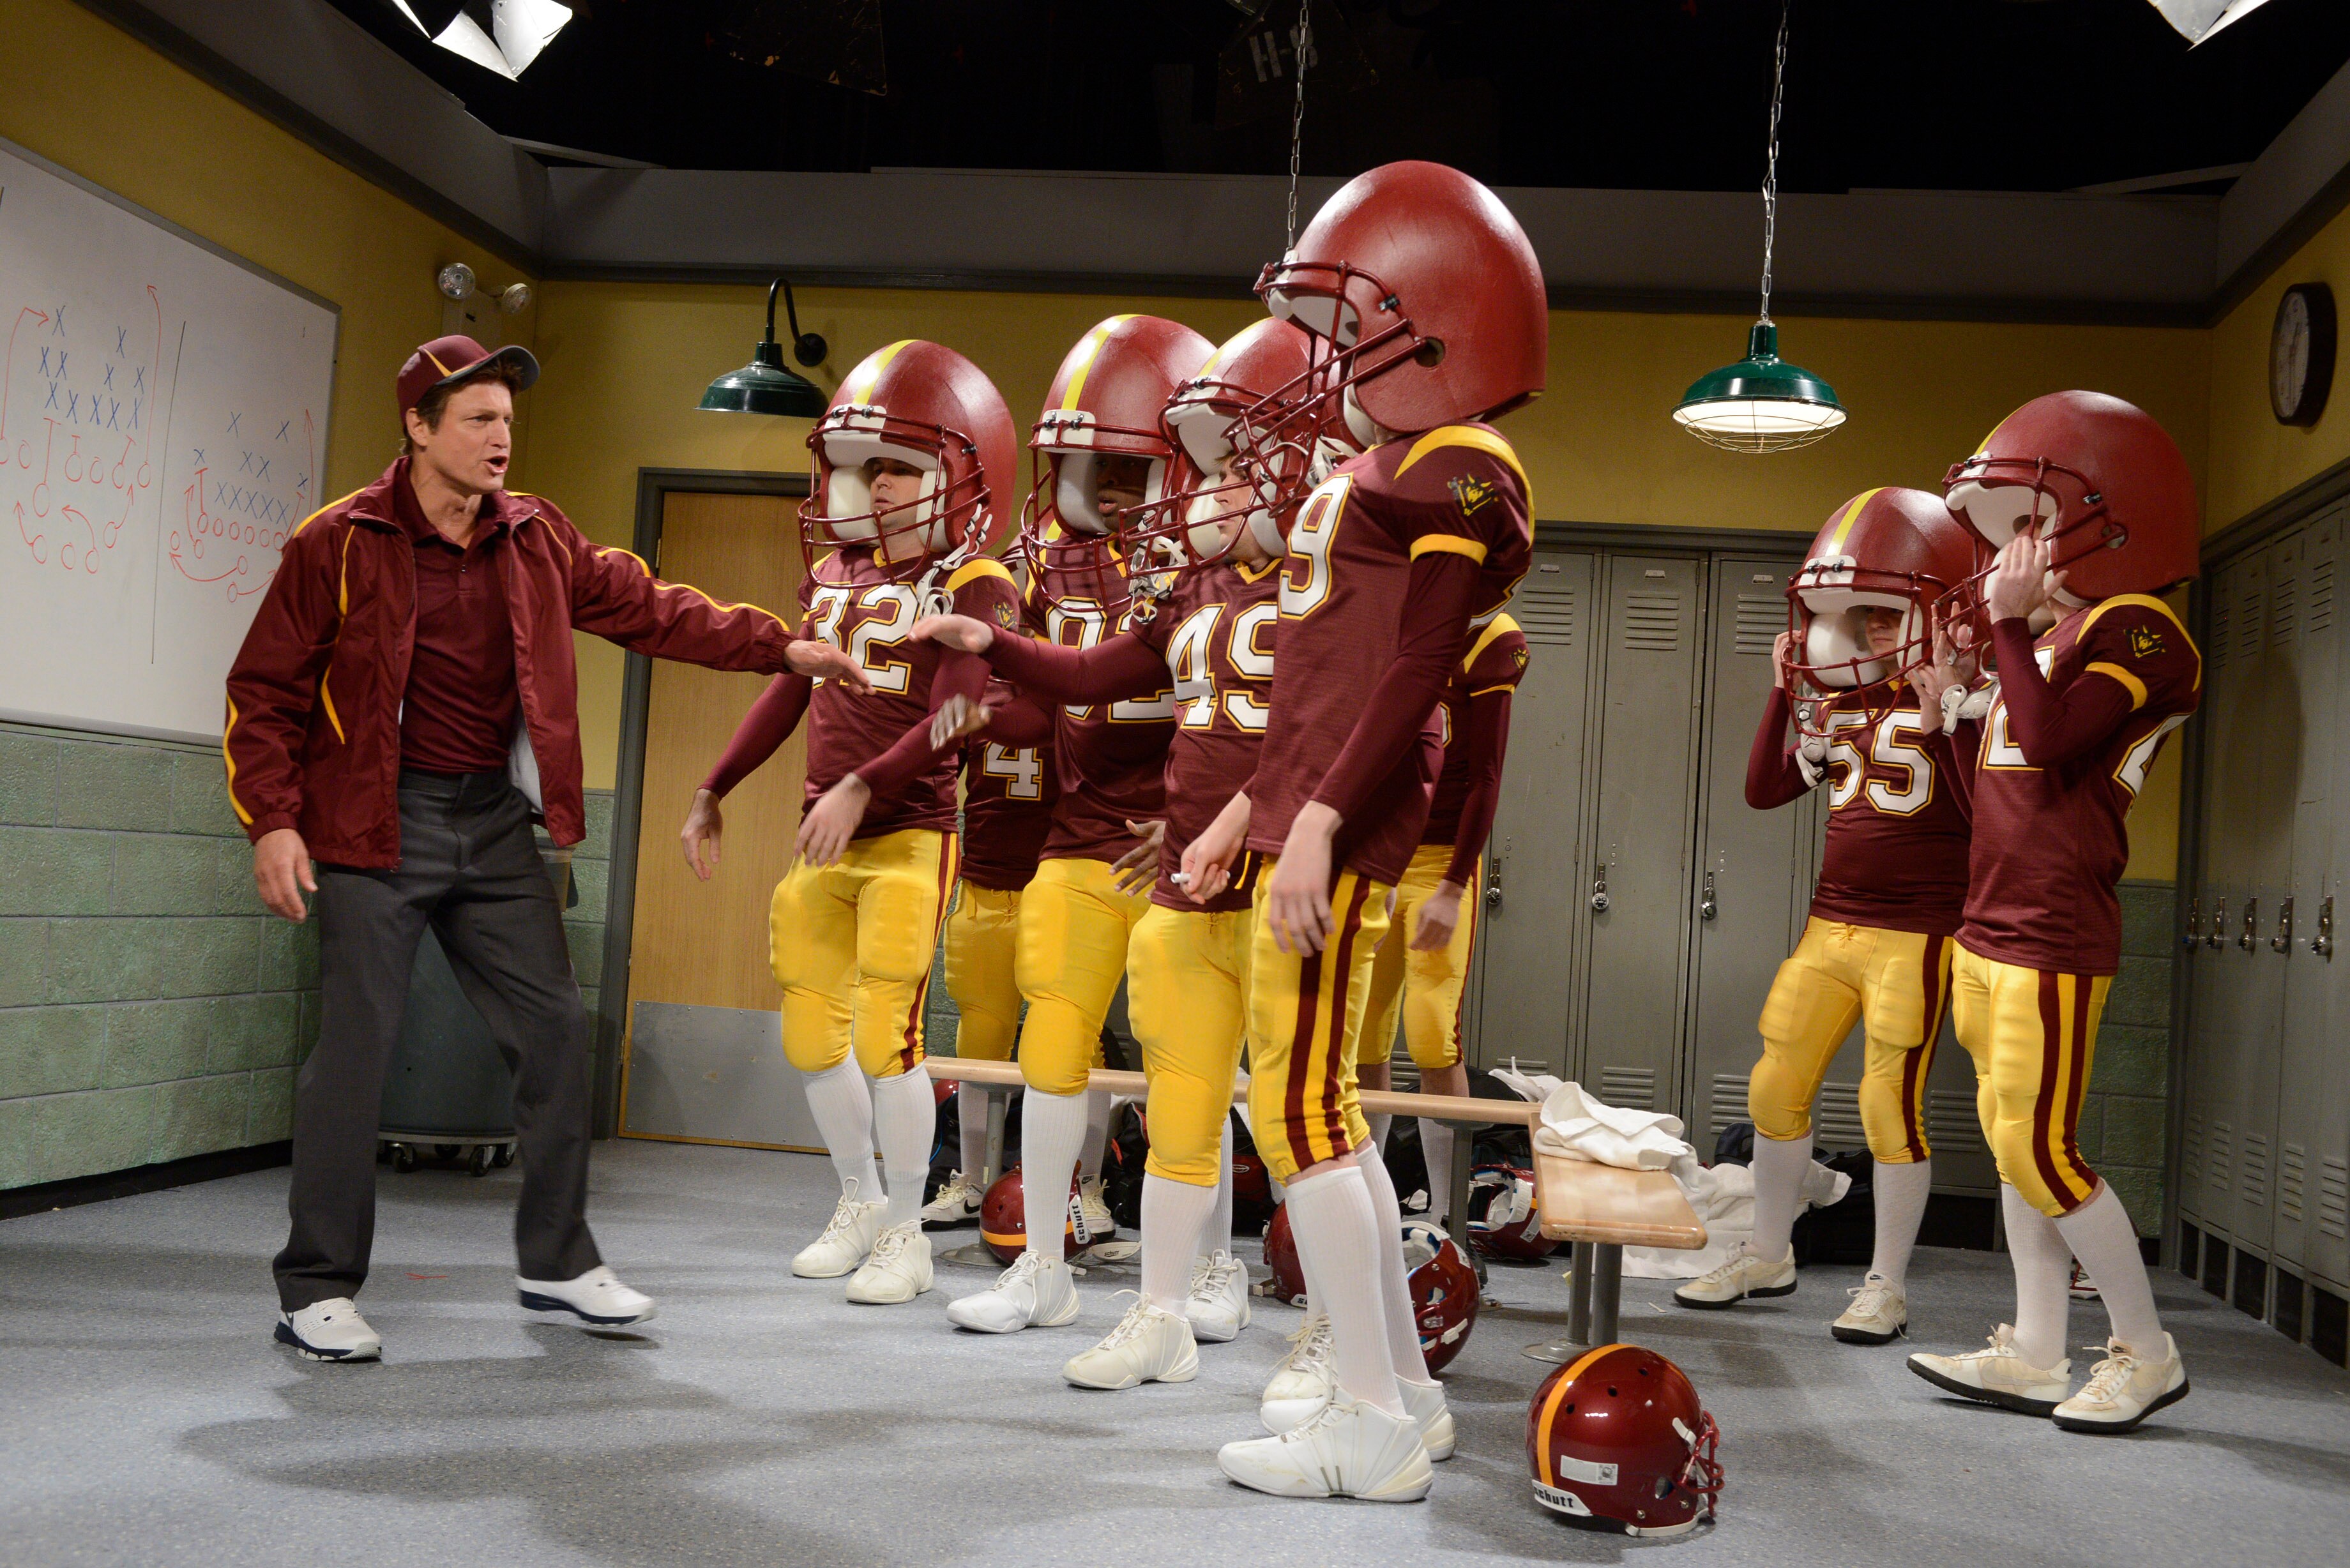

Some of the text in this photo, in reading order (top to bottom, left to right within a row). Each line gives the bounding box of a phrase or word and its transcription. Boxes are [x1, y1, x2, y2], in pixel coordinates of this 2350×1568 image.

[809, 580, 921, 695] 32
[1823, 708, 1935, 817] 55
[1072, 1205, 1086, 1241] schutt
